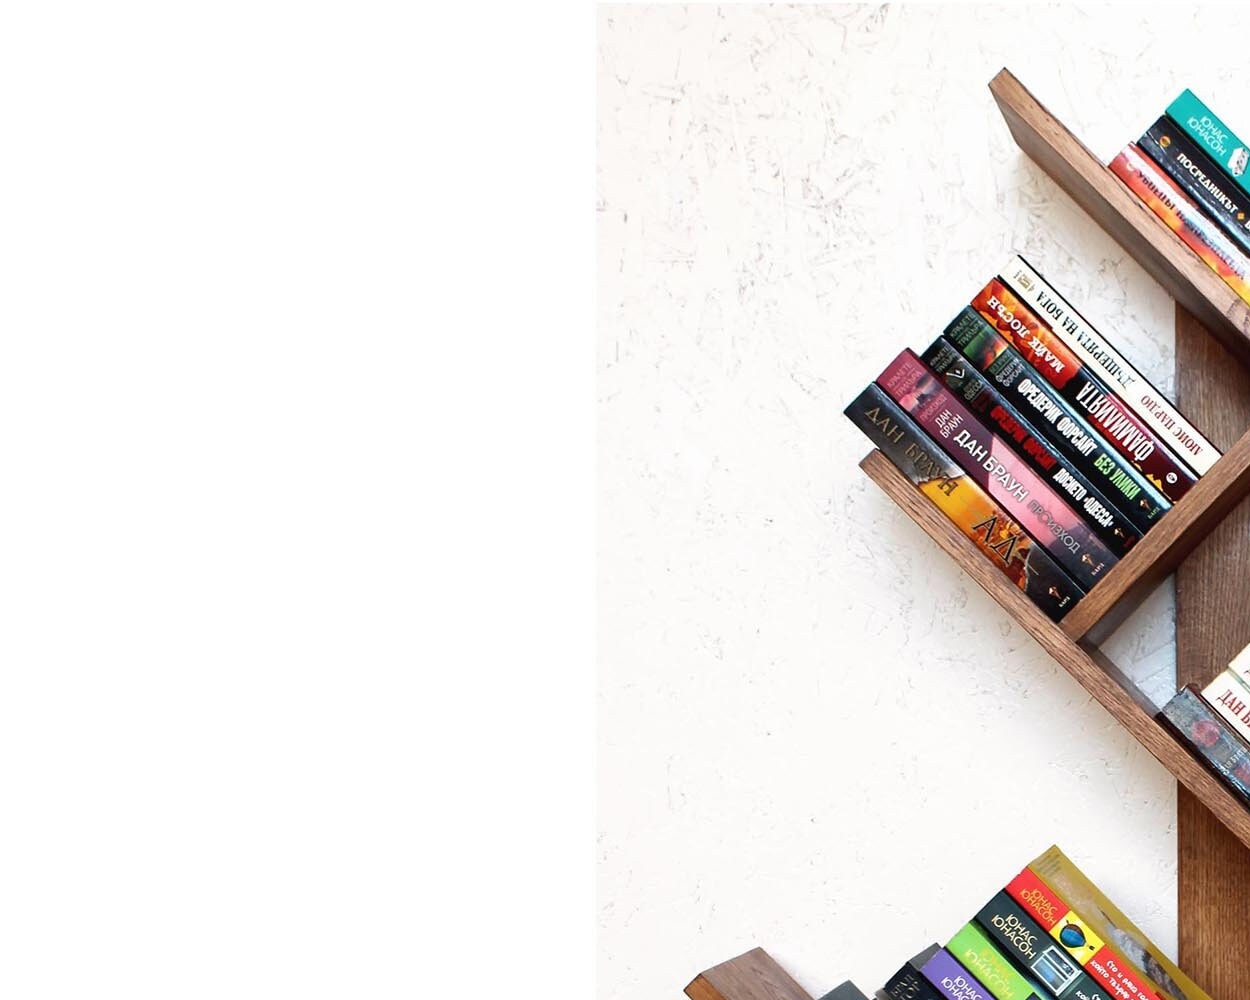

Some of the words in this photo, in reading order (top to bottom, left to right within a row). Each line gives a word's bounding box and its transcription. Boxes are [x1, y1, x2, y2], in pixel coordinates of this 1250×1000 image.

[1185, 115, 1227, 158] ЮНАСОН
[1198, 114, 1229, 145] ЮНАС
[1174, 151, 1239, 215] ПОСРЕДНИКЪТ
[984, 294, 1031, 340] ЛОСЪН
[1033, 289, 1065, 321] БОГА
[1059, 315, 1080, 336] НА
[1025, 334, 1066, 375] МАЙК
[1074, 329, 1136, 391] ДЪЩЕРЯТА
[932, 407, 954, 429] ДАН
[937, 412, 965, 439] БРАУН
[1014, 375, 1065, 425] ФРЕДЕРИК
[1053, 413, 1099, 459] ФОРСАЙТ
[1071, 378, 1158, 465] ФАМИЛИЯТА
[1138, 392, 1177, 431] ПАРДЮ
[862, 401, 906, 445] ДАН
[902, 440, 960, 498] БРАУН
[1171, 425, 1204, 458] ЛЮИС
[951, 427, 989, 464] ДАН
[980, 454, 1030, 503] БРАУН
[1051, 465, 1089, 503] ДОСИЕТО
[1091, 451, 1117, 477] БЕЗ
[1107, 466, 1142, 501] УЛИКИ
[968, 508, 1029, 568] АД
[1024, 497, 1082, 555] ПРОИЗХОД
[1214, 686, 1247, 719] ДАН
[1018, 887, 1058, 927] ЮНАСОН
[1029, 886, 1059, 916] ЮНАС
[989, 912, 1037, 961] ЮНАСОН
[1004, 912, 1038, 946] ЮНАС
[962, 946, 1017, 1000] ЮНАСОН
